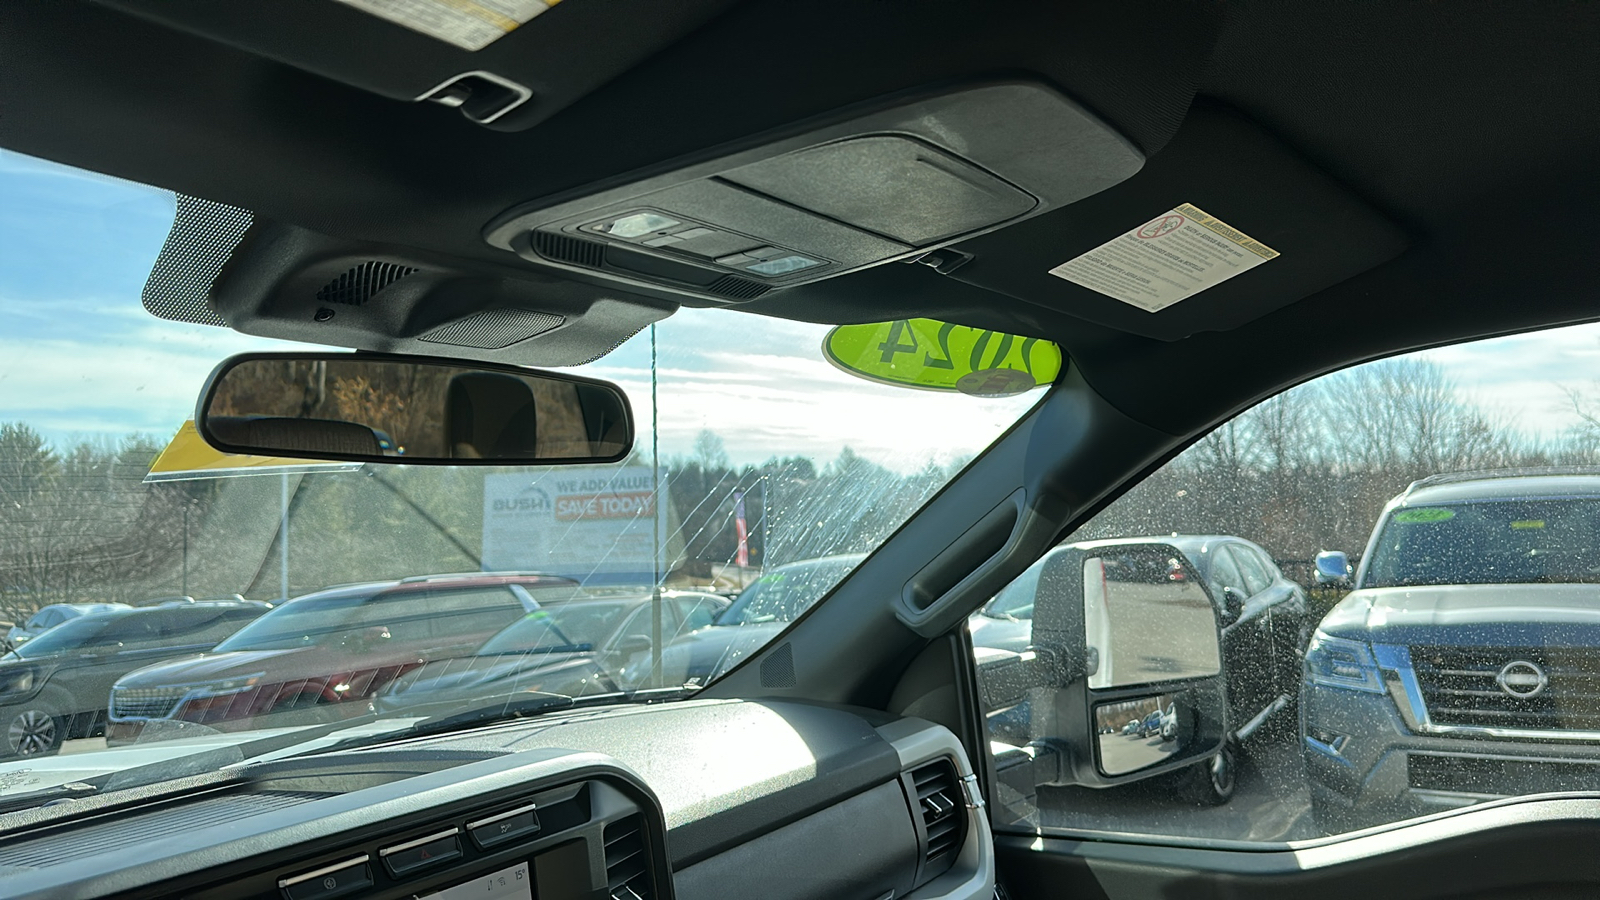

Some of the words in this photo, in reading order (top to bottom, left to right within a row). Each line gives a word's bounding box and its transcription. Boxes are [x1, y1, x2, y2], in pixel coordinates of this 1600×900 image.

[557, 480, 577, 492] WE
[580, 478, 608, 491] ADD
[558, 499, 598, 516] SAVE
[599, 496, 653, 514] TODAY
